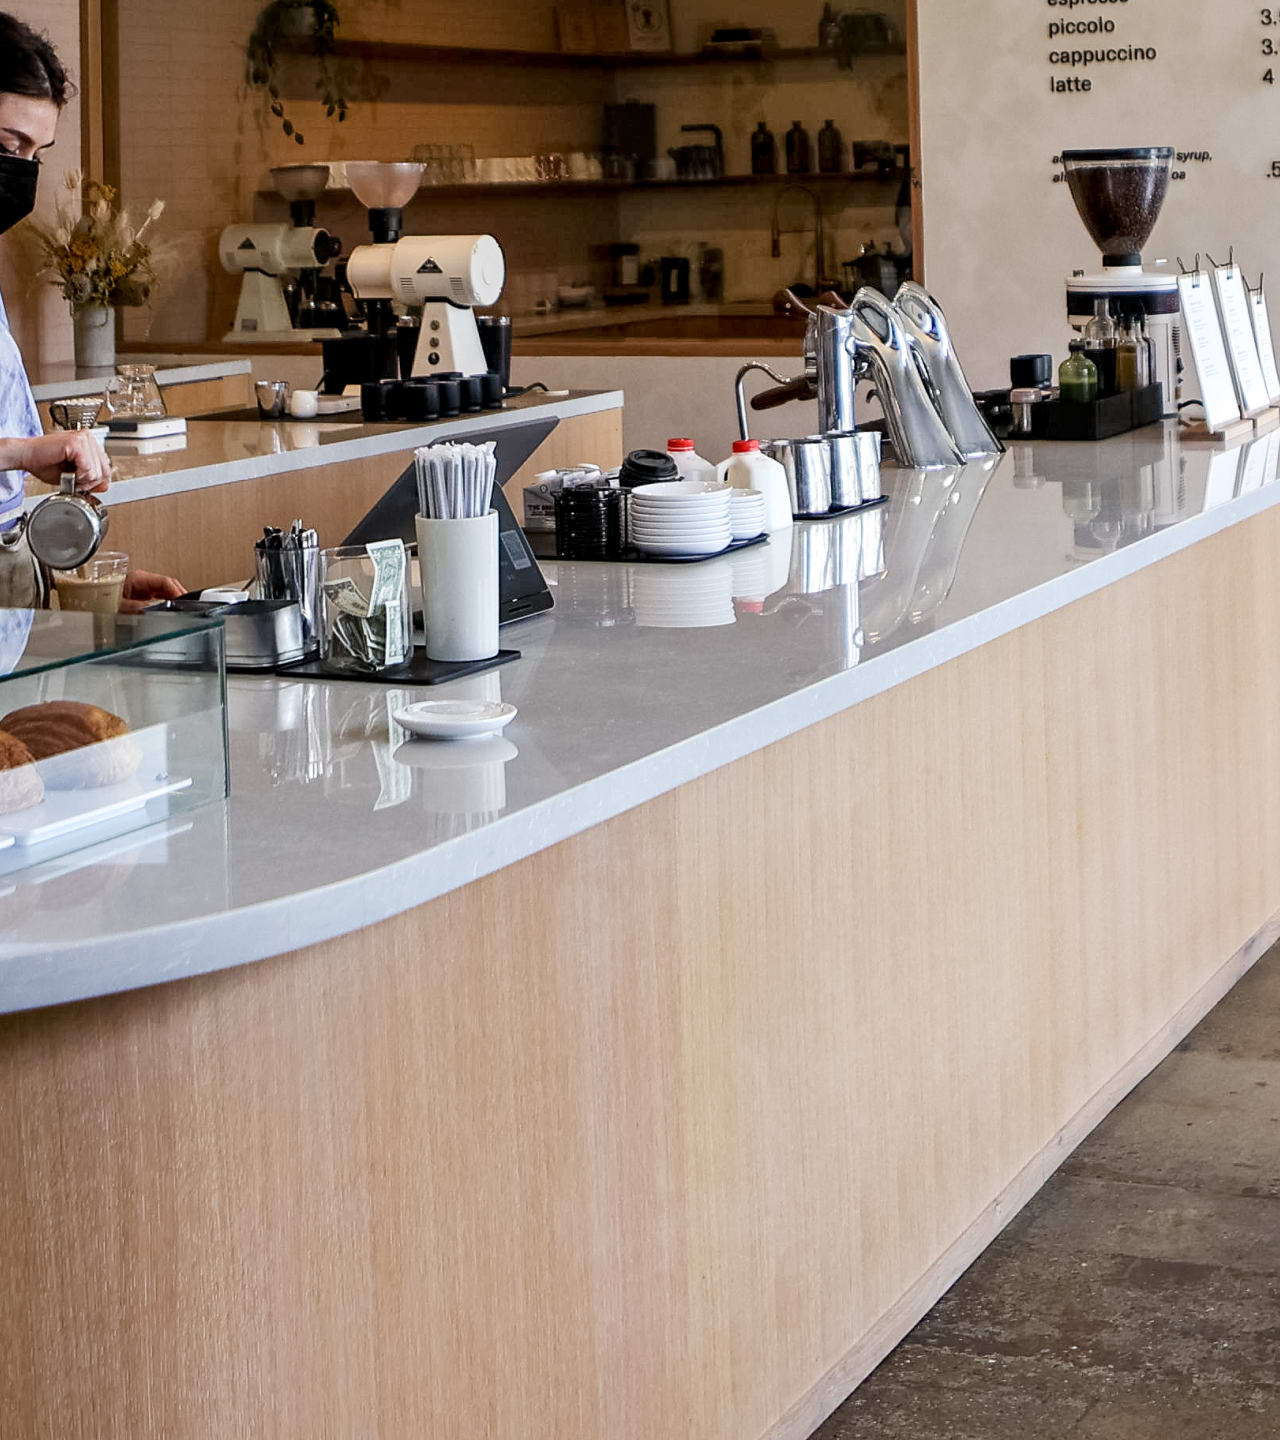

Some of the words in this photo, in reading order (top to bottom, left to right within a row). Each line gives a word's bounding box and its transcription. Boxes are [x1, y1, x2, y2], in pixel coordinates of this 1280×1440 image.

[1048, 15, 1115, 39] piccolo
[1048, 44, 1157, 67] cappuccino
[1050, 76, 1092, 93] latte
[1262, 68, 1275, 85] 4
